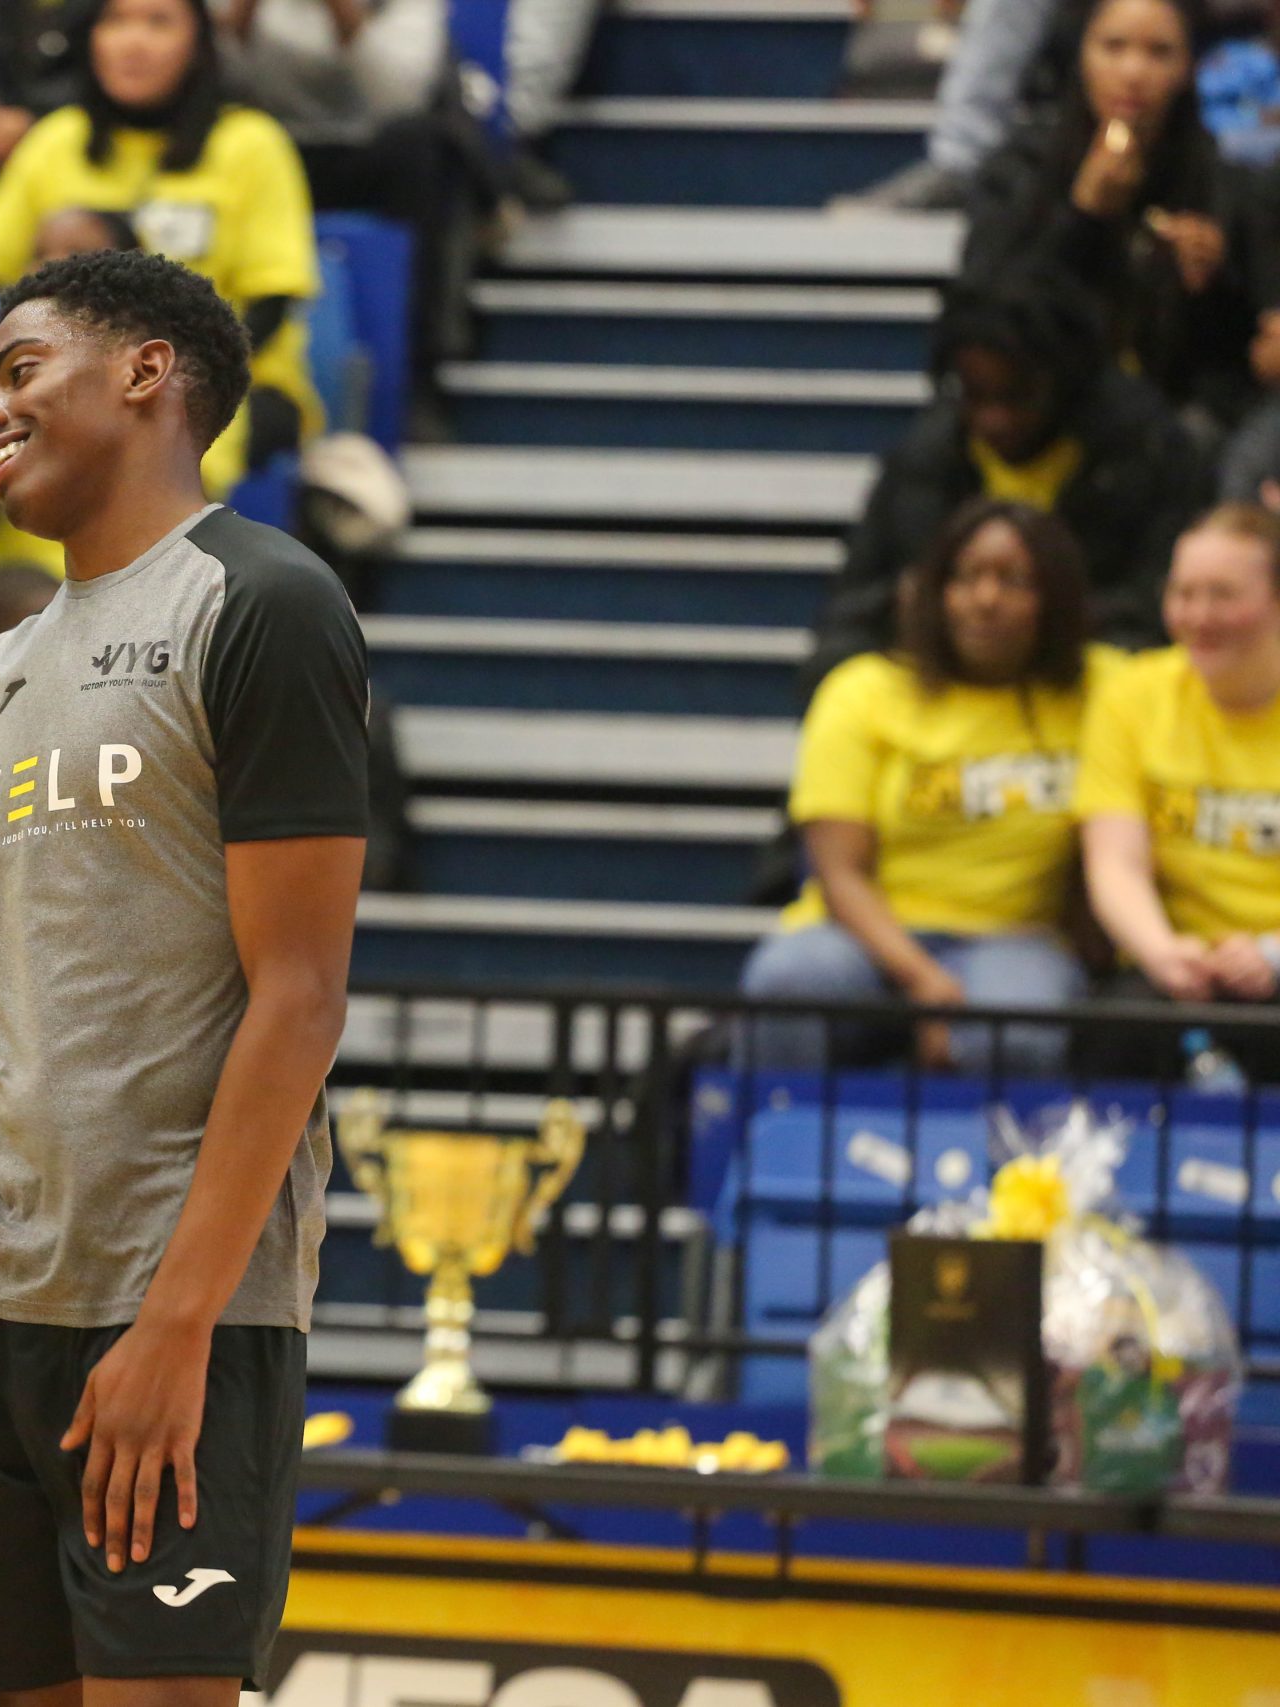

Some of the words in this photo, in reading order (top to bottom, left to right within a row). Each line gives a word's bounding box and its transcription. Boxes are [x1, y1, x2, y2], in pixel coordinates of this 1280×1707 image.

[98, 640, 170, 675] VYG
[81, 681, 107, 691] VICTORY
[109, 679, 134, 687] YOUTH
[138, 680, 167, 688] ROUP
[27, 825, 52, 836] YOU,
[56, 821, 77, 832] I'LL
[81, 818, 113, 829] HELP
[119, 818, 146, 828] YOU
